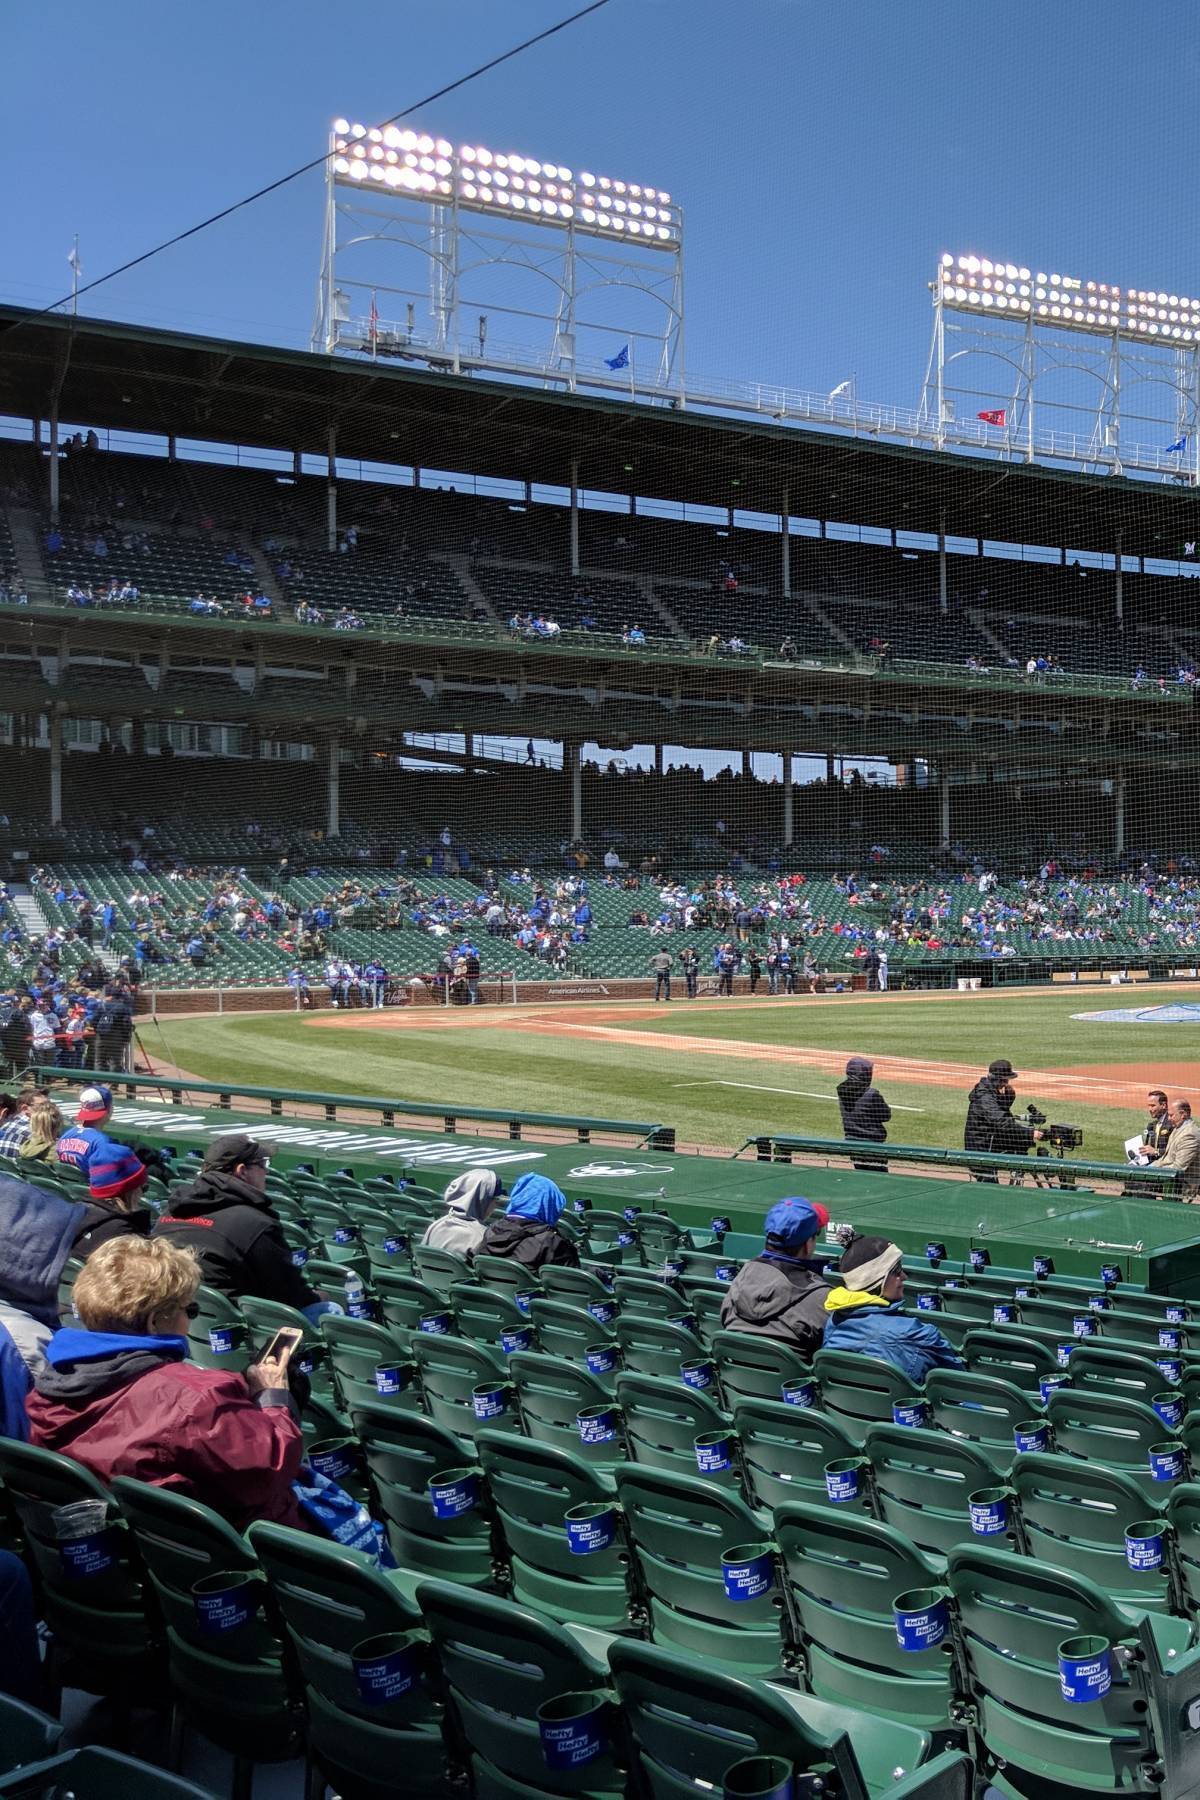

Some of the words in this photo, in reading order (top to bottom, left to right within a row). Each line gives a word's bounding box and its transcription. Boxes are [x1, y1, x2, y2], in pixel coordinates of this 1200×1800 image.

[377, 1143, 547, 1166] FIELD
[727, 1569, 750, 1578] Hefty
[738, 1575, 759, 1587] Hefty
[904, 1616, 928, 1627] Hefty
[915, 1622, 938, 1636] Hefty
[1076, 1663, 1100, 1676] Hefty
[1088, 1670, 1108, 1686] Hefty
[546, 1728, 573, 1739] Hefty
[558, 1735, 588, 1750] Hefty
[573, 1742, 599, 1762] Hefty
